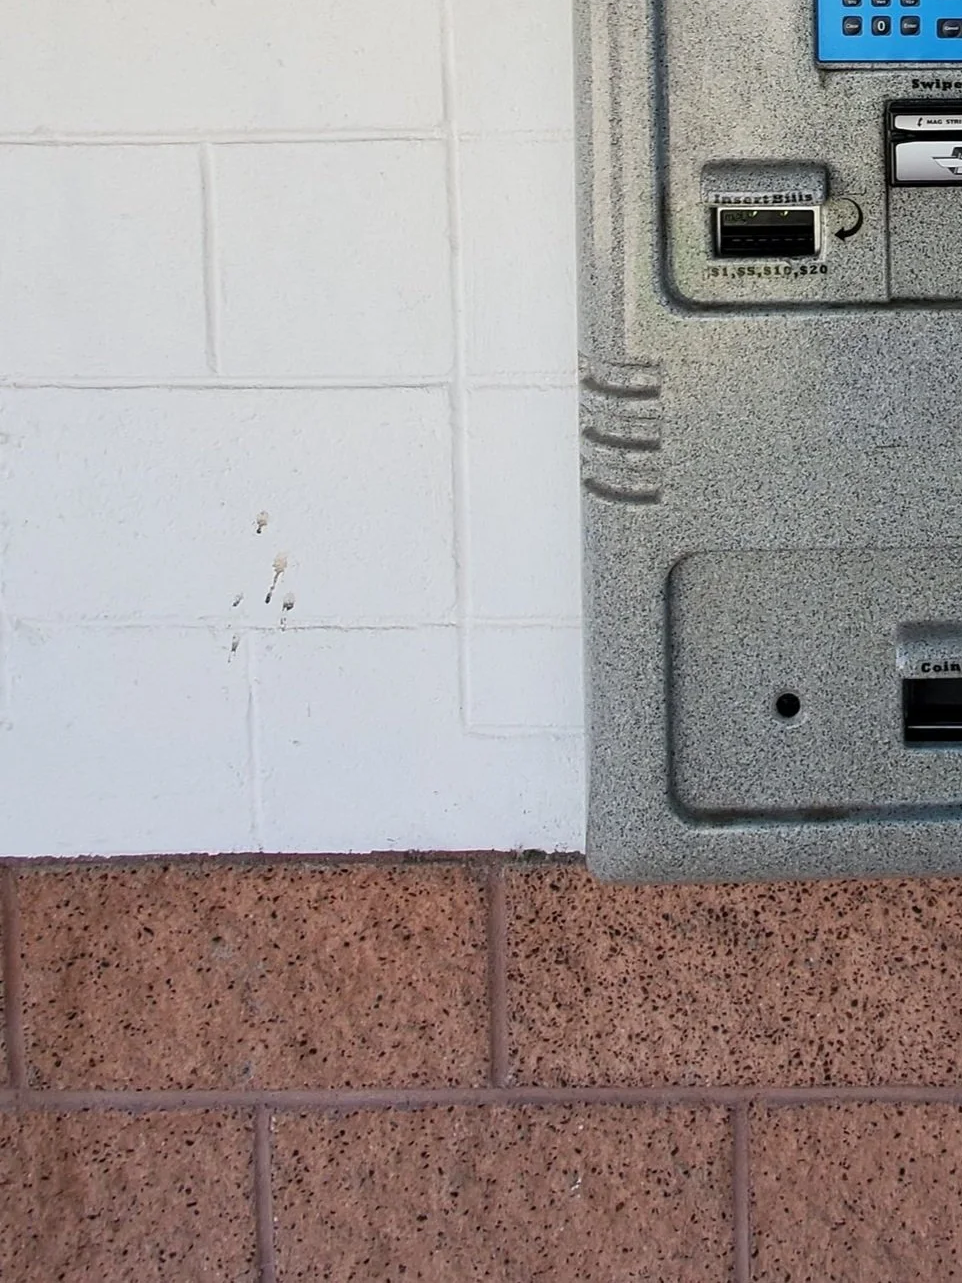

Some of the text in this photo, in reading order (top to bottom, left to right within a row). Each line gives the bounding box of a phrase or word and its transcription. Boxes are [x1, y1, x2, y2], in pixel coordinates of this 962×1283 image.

[877, 20, 885, 31] 0
[912, 79, 962, 91] Swipe
[713, 193, 813, 204] Insert Bills
[921, 661, 961, 673] Coin
